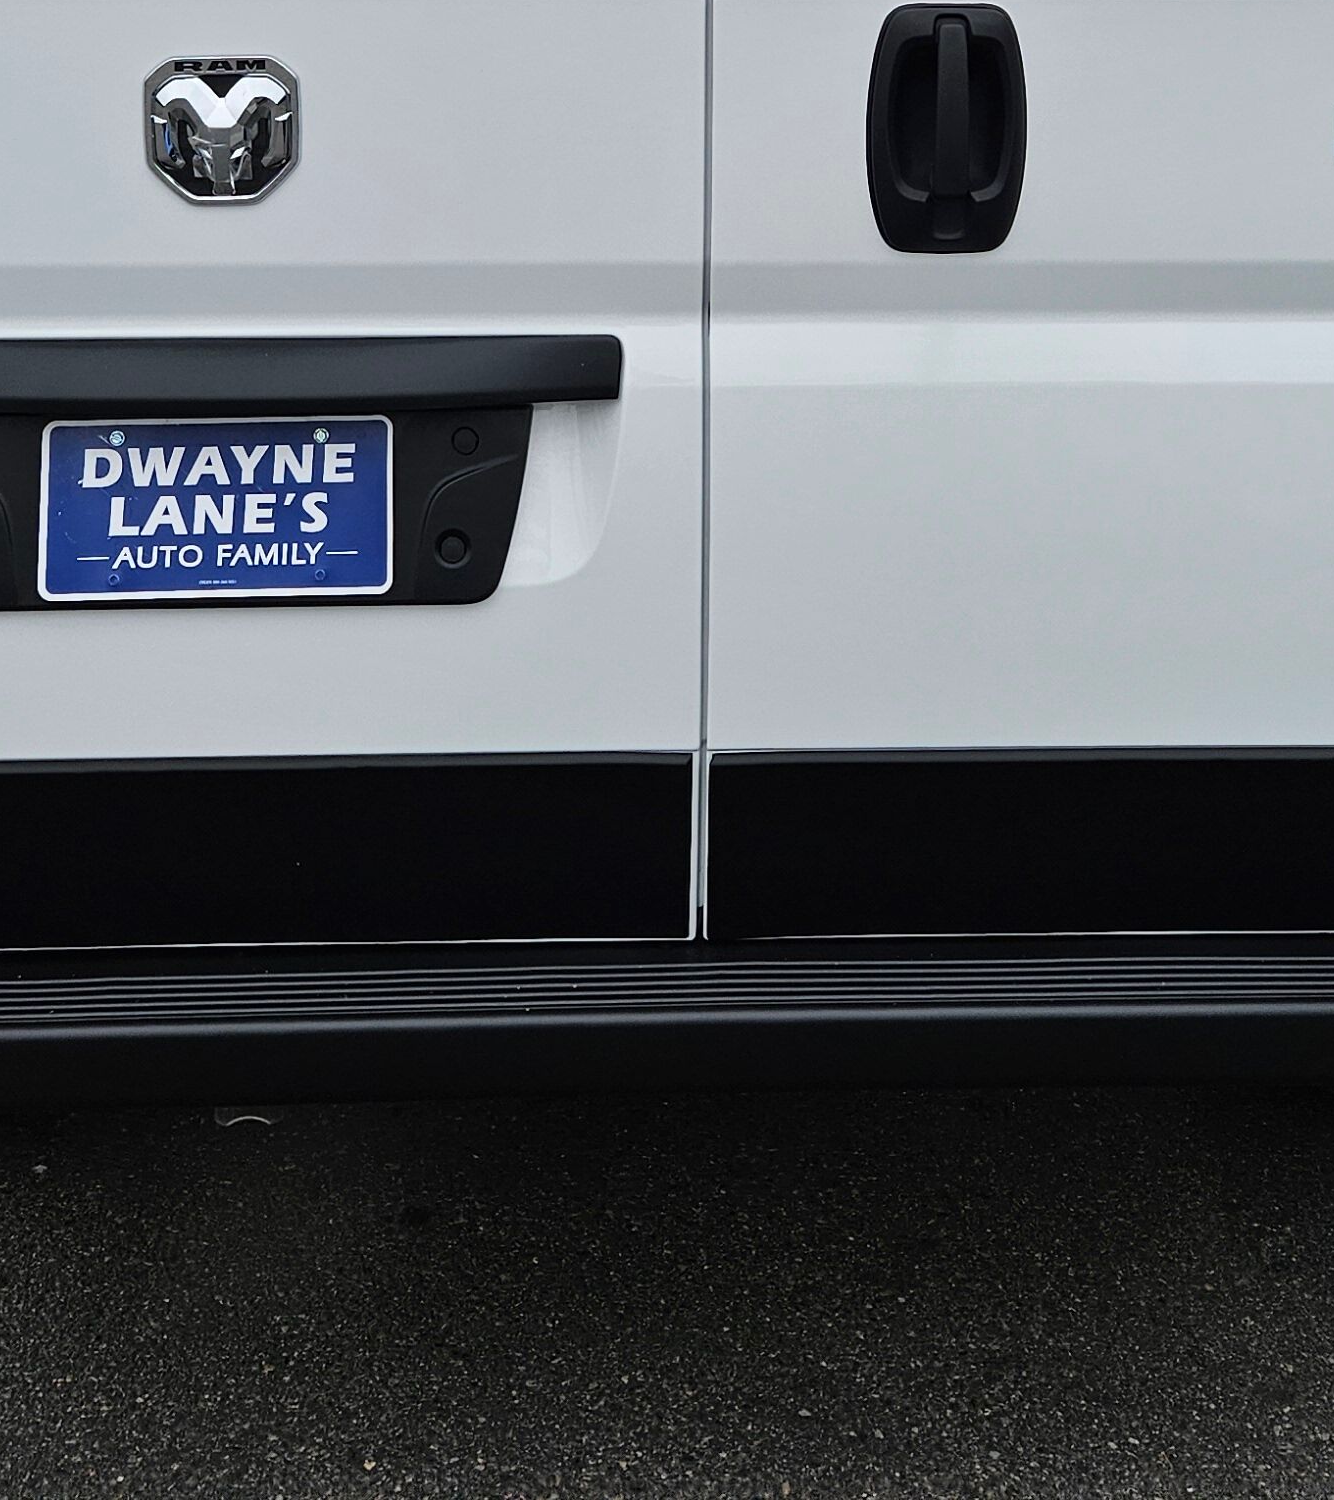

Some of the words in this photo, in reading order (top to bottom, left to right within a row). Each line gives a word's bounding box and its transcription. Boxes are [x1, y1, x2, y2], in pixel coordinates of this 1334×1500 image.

[174, 59, 266, 72] RAM
[81, 442, 356, 488] DWAYNE
[107, 491, 329, 537] LANE'S
[111, 543, 204, 570] AUTO
[215, 541, 325, 567] FAMILY
